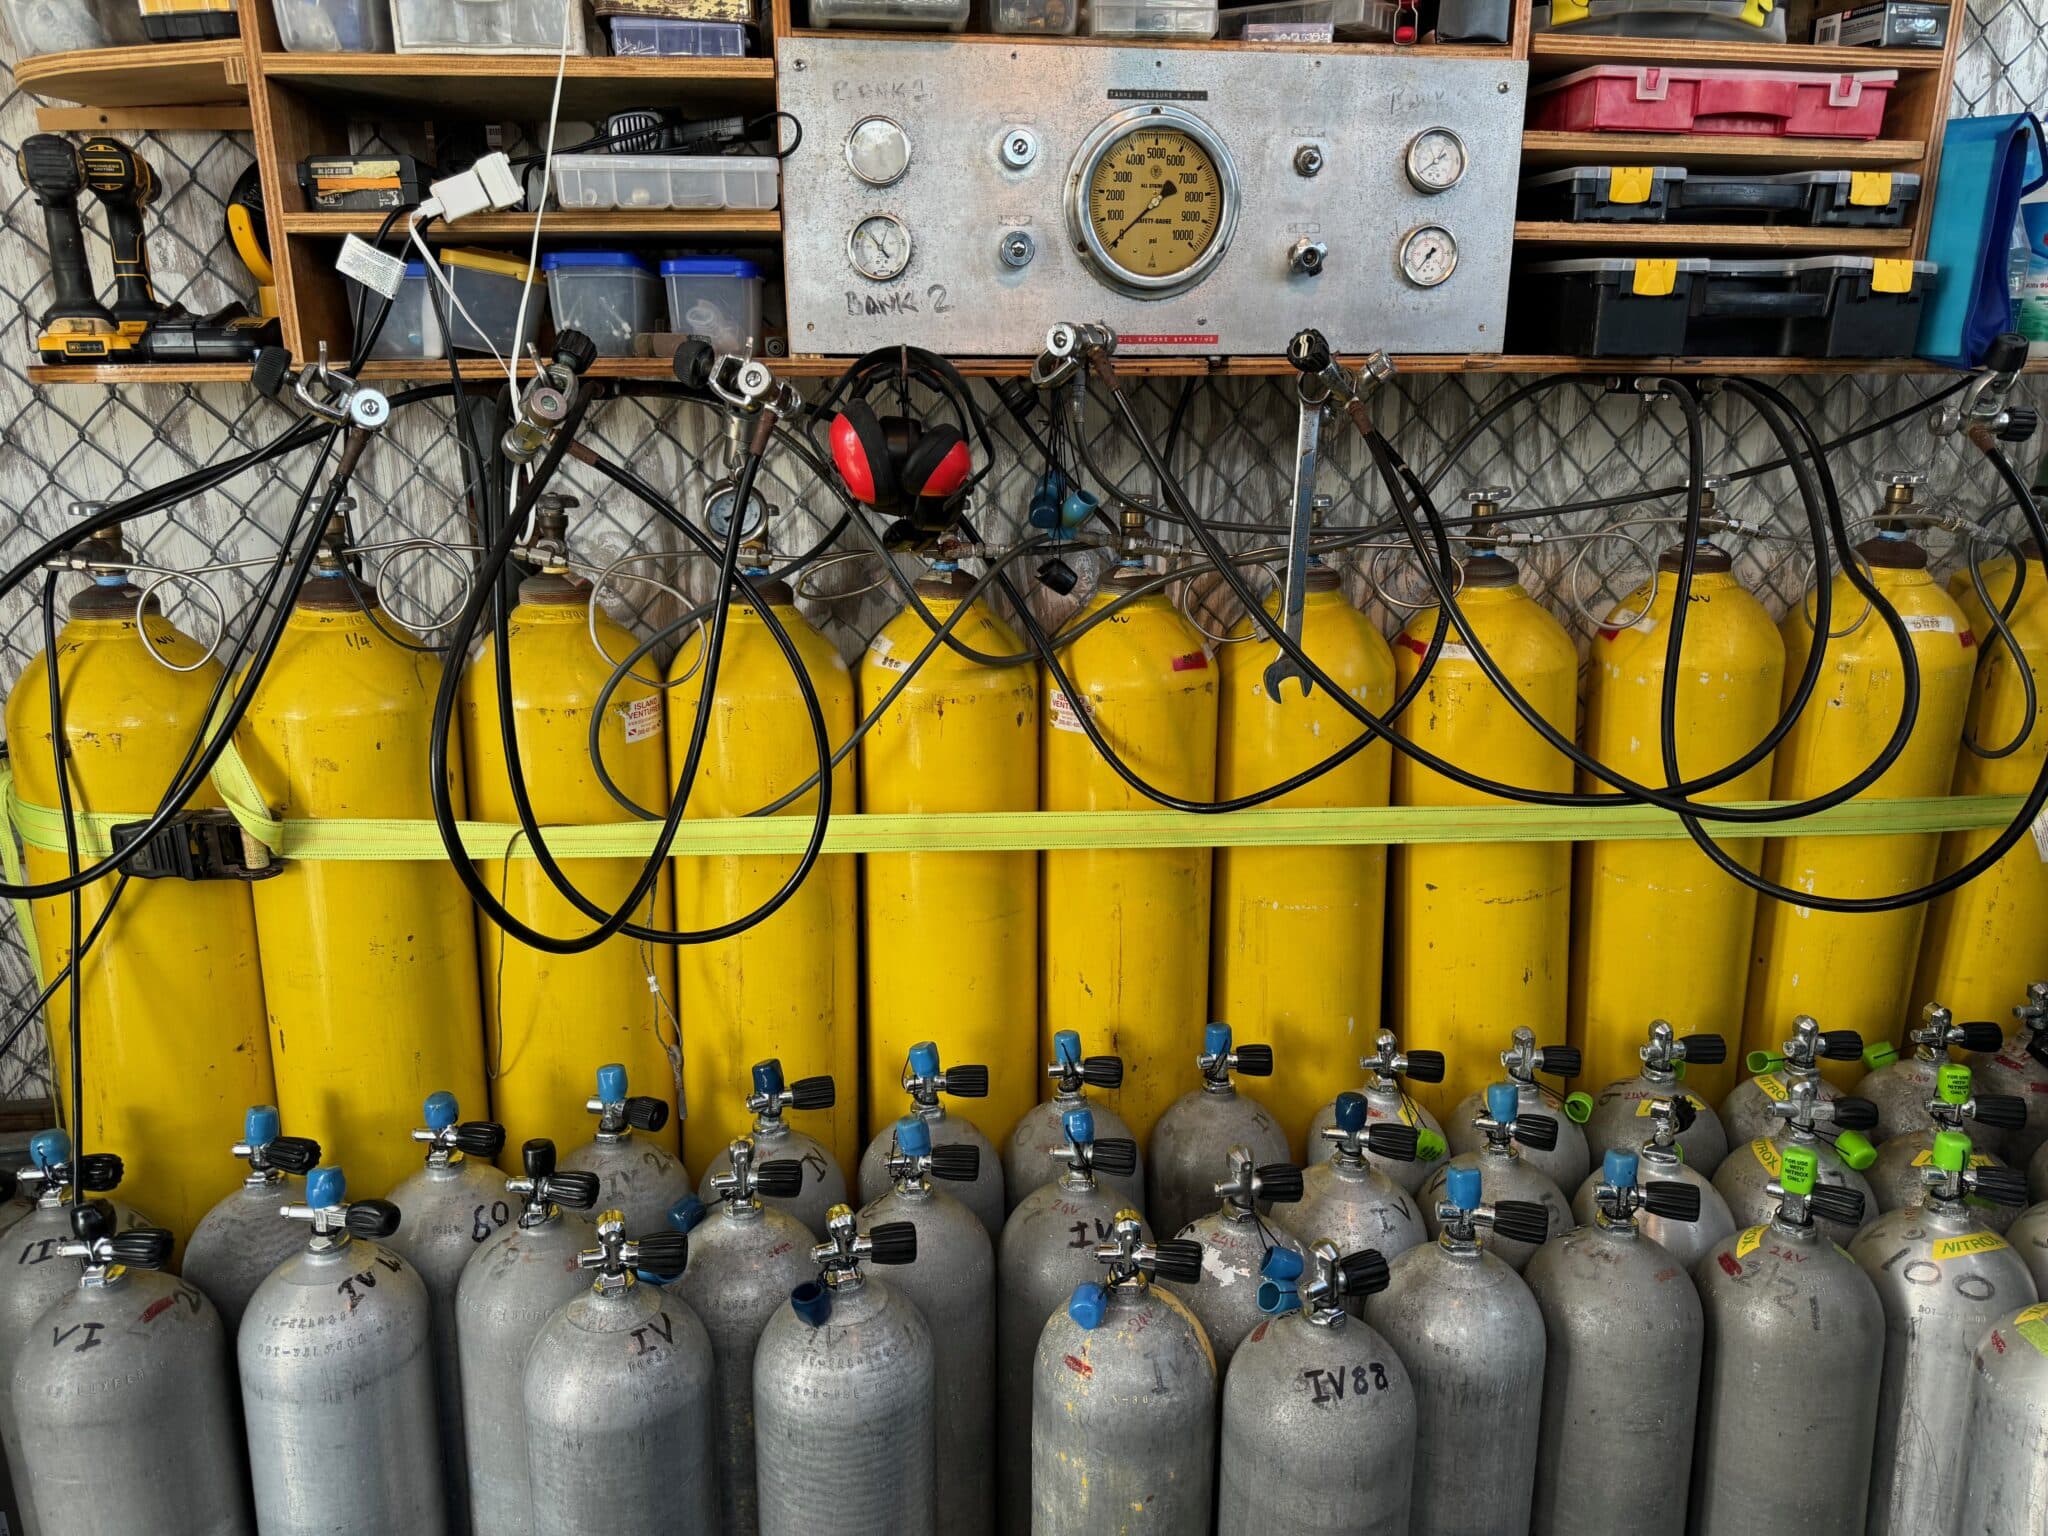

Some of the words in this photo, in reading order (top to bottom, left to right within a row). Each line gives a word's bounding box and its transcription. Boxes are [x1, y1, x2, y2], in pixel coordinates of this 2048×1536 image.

[1147, 147, 1166, 159] 5000
[1126, 154, 1145, 166] 4000
[1166, 155, 1185, 166] 6000
[1113, 171, 1132, 183] 3000
[1179, 172, 1198, 184] 7000
[1106, 189, 1125, 201] 2000
[1185, 191, 1204, 202] 8000
[1107, 209, 1124, 221] 1000
[1181, 210, 1200, 222] 9000
[1149, 237, 1157, 245] psi
[1172, 230, 1194, 241] 10000
[845, 291, 919, 316] BANK
[927, 284, 952, 313] 2
[634, 697, 658, 711] ISLAND
[1784, 1157, 1796, 1165] FOR
[1784, 1168, 1809, 1178] NITROX
[1789, 1164, 1805, 1172] WITH
[1786, 1175, 1805, 1183] ONLY
[1069, 1217, 1115, 1249] IV
[1942, 1234, 2003, 1255] NITROX
[1768, 1246, 1808, 1263] 24V
[53, 1322, 105, 1352] VI
[630, 1312, 674, 1356] IV
